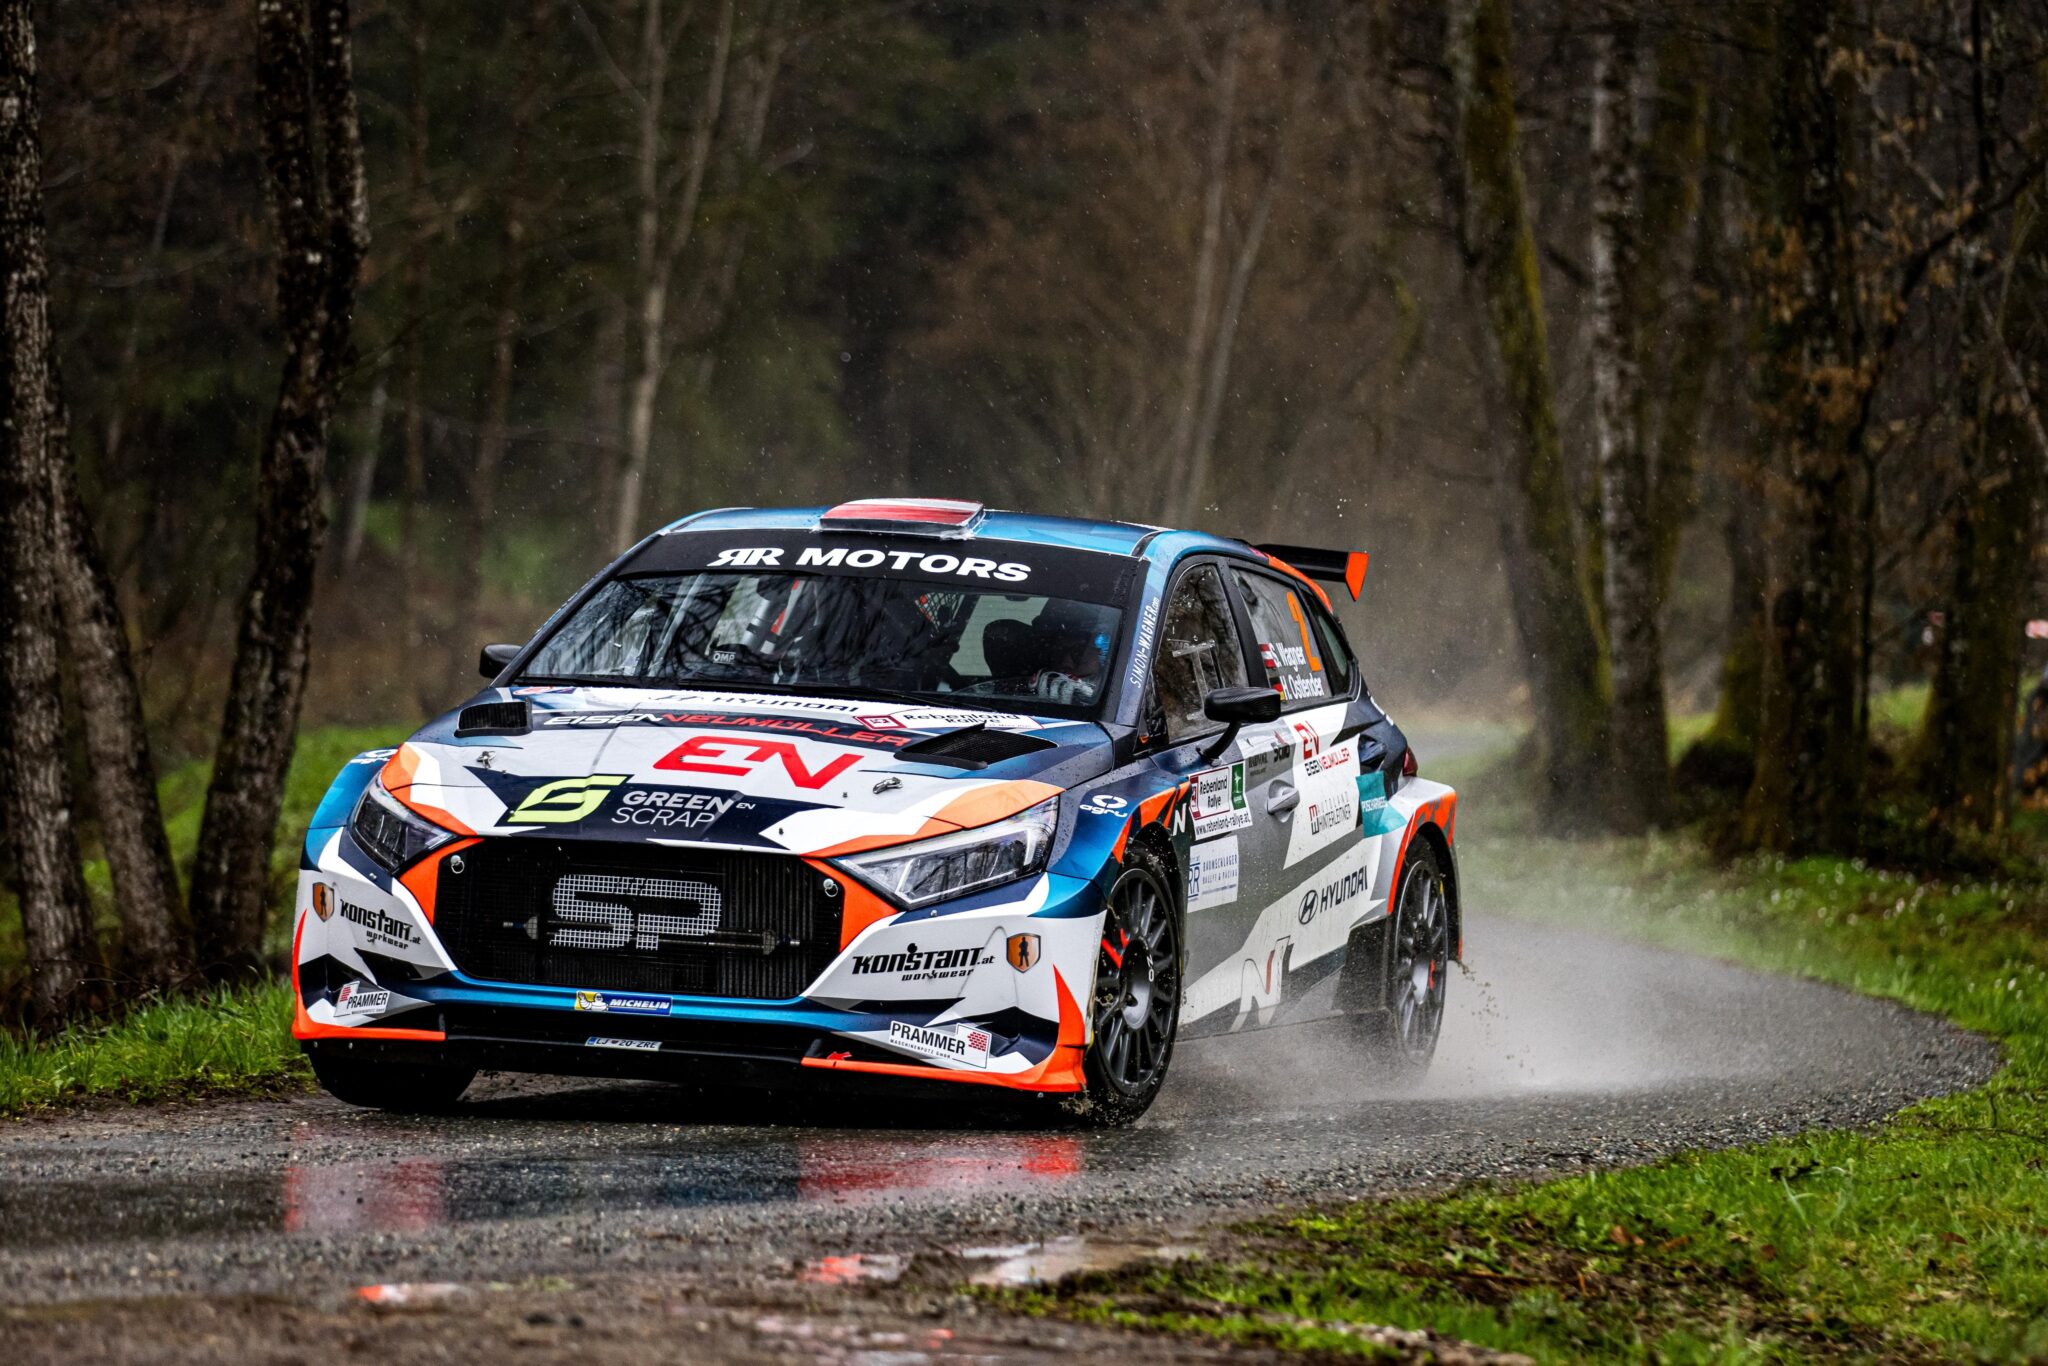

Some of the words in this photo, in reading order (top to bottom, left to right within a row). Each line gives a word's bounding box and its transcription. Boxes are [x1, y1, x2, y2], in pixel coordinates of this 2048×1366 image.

[796, 547, 1032, 582] MOTORS
[1286, 591, 1322, 672] 2
[713, 652, 735, 663] OMP
[712, 697, 859, 712] HYUNDAI
[1200, 774, 1228, 795] Rebenland
[622, 790, 735, 814] GREEN
[1079, 804, 1128, 818] agru
[1207, 794, 1222, 809] Rallye
[611, 807, 716, 828] SCRAP
[1319, 864, 1368, 913] HYUNDAI
[549, 873, 722, 951] SP
[901, 968, 974, 982] workwear
[346, 992, 389, 1010] PRAMMER
[609, 998, 670, 1010] MICHELIN
[891, 1022, 966, 1056] PRAMMER
